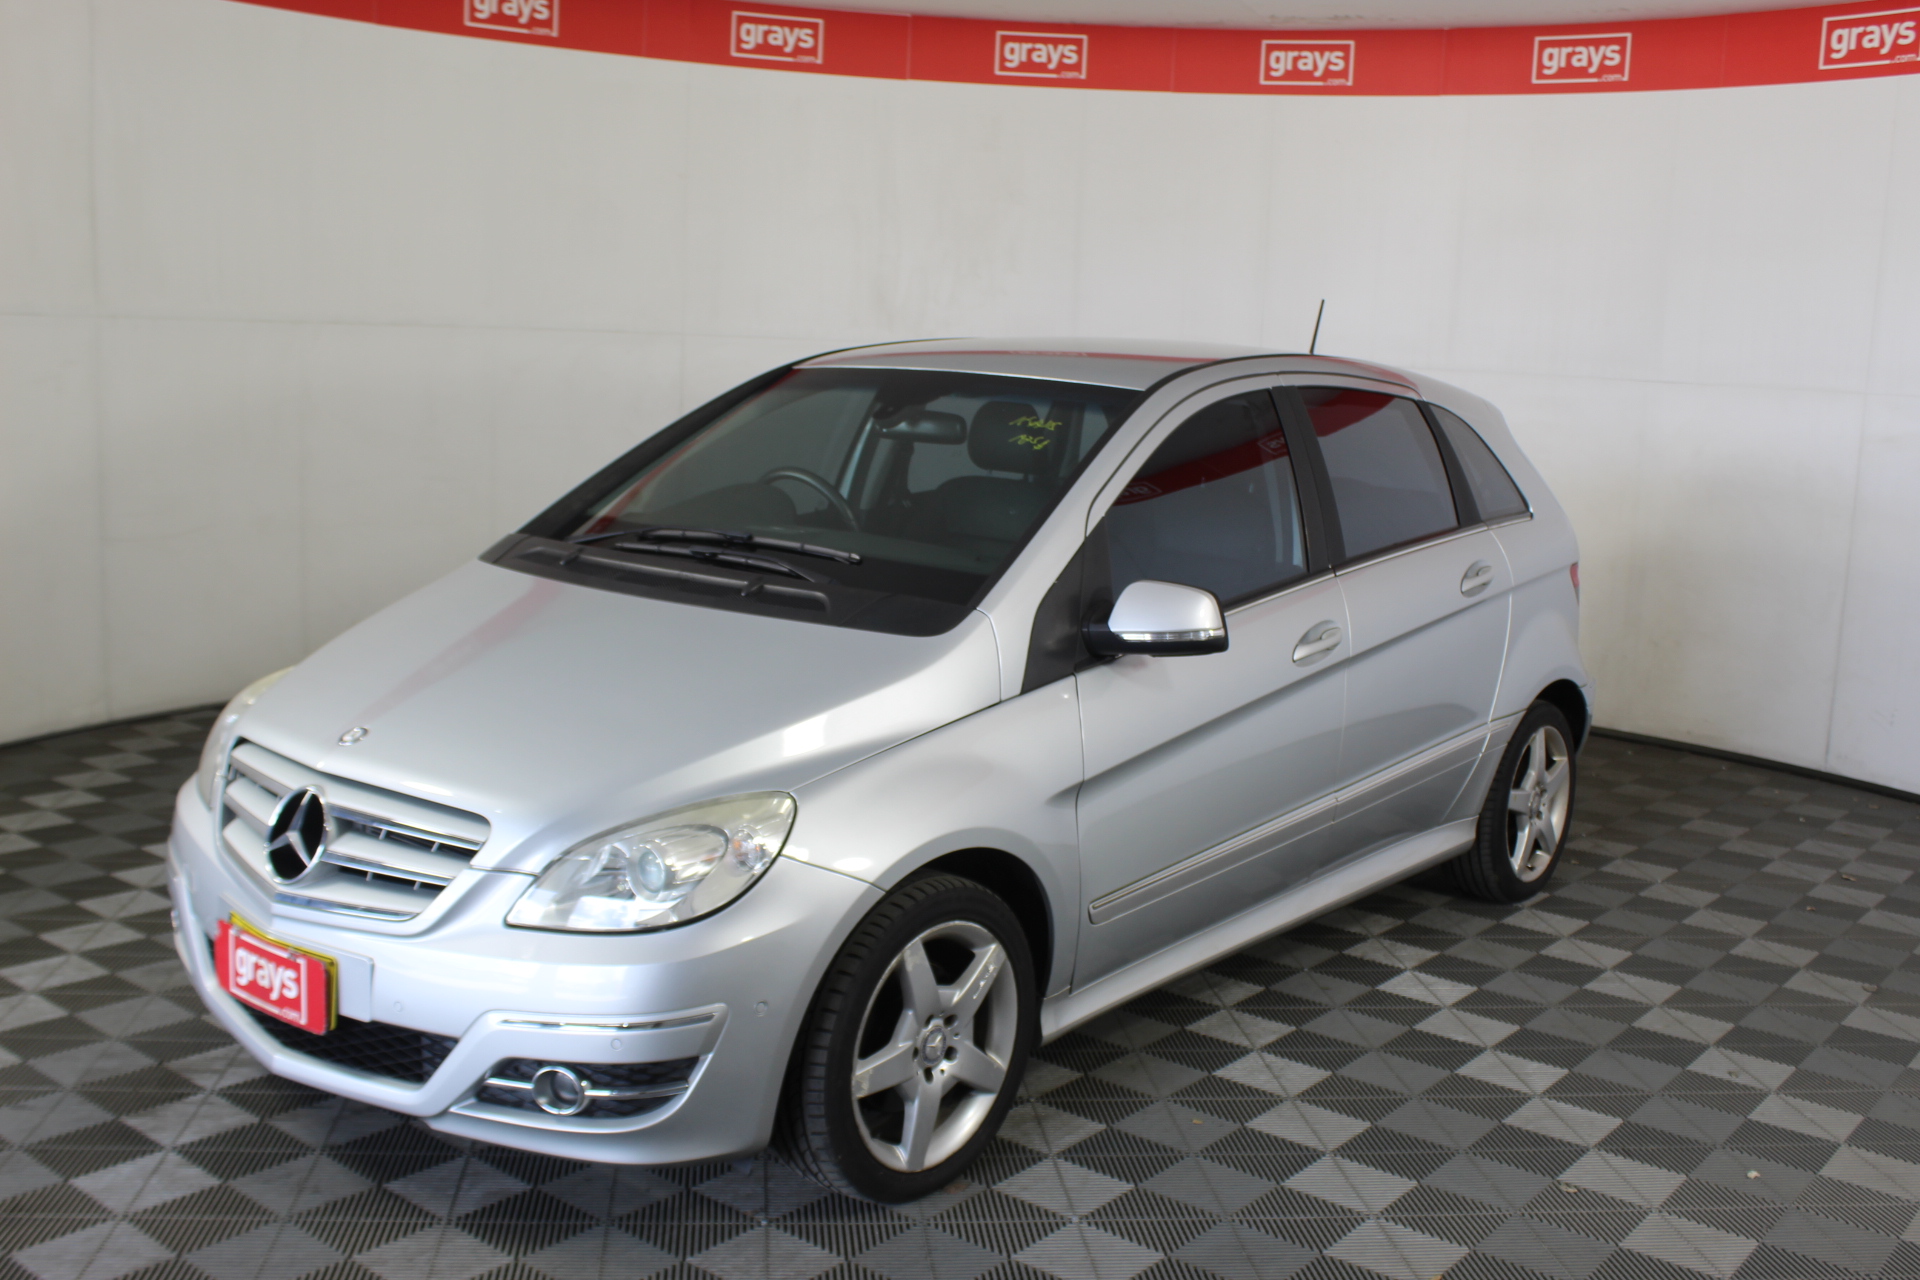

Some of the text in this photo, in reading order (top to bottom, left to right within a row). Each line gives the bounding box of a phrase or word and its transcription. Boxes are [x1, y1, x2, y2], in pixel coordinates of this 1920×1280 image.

[474, 0, 549, 24] grays
[739, 22, 815, 53] grays
[1829, 20, 1917, 60] grays
[1003, 41, 1079, 70] grays
[1269, 50, 1346, 77] grays
[1541, 44, 1622, 75] grays
[235, 947, 300, 1001] grays
